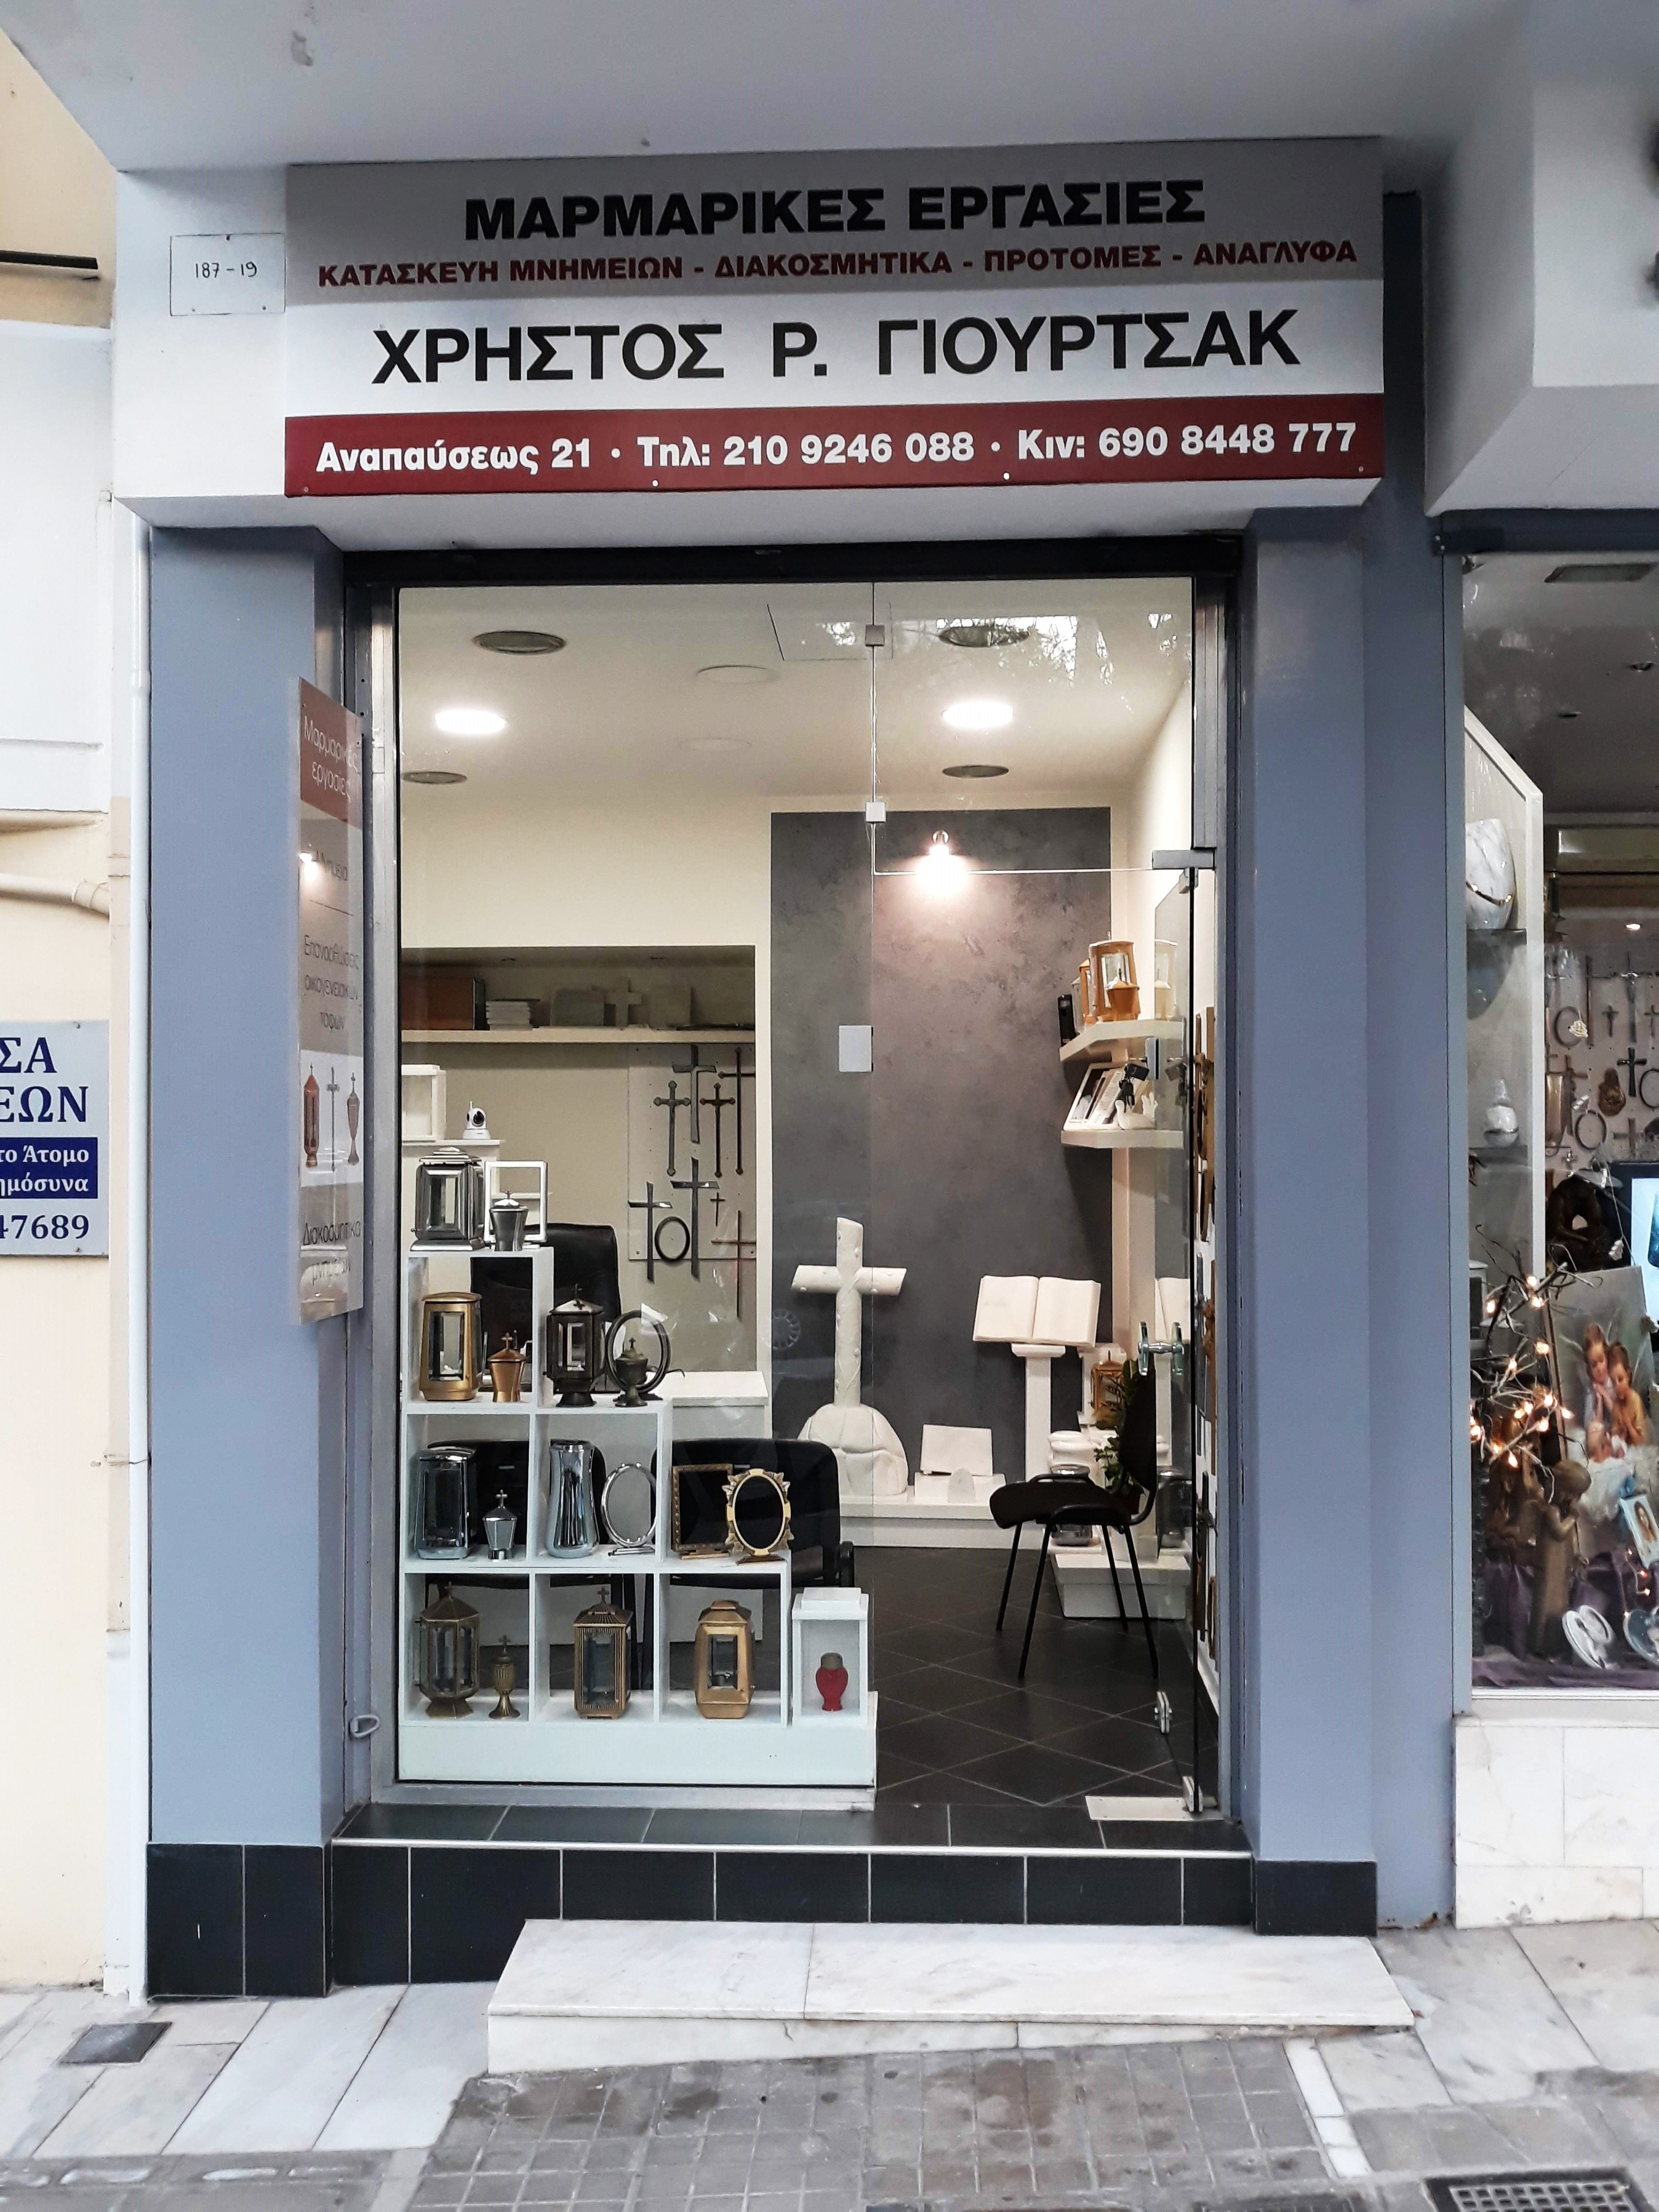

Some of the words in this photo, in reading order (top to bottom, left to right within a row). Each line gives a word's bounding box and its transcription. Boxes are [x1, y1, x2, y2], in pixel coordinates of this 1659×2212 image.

[465, 188, 886, 241] ΜΑΡΜΑΡΙΚΕΣ
[909, 180, 1206, 231] ΕΡΓΑΣΙΕΣ
[319, 260, 498, 287] ΚΑΤΑΣΚΕΥΗ
[510, 256, 682, 282] ΜΝΗΜΕΙΩΝ
[714, 250, 952, 278] ΔΙΑΚΟΣΜΗΤΙΚΑ
[985, 244, 1161, 272] ΠΡΟΤΟΜΕΣ
[1193, 239, 1357, 265] ΑΝΑΓΛΥΦΑ
[372, 324, 724, 384] ΧΡΗΣΤΟΣ
[773, 322, 827, 377] Ρ.
[878, 309, 1301, 375] ΓΙΟΥΡΤΣΑΚ
[316, 439, 540, 475] Αναπαύσεως
[551, 438, 590, 468] 21
[637, 436, 711, 467] Τηλ:
[723, 435, 788, 466] 210
[801, 433, 892, 464] 9246
[905, 431, 974, 462] 088
[1019, 429, 1085, 460] Κιν:
[1099, 426, 1168, 457] 690
[1181, 424, 1275, 455] 8448
[1289, 422, 1356, 452] 777
[23, 1145, 89, 1167] Άτομο
